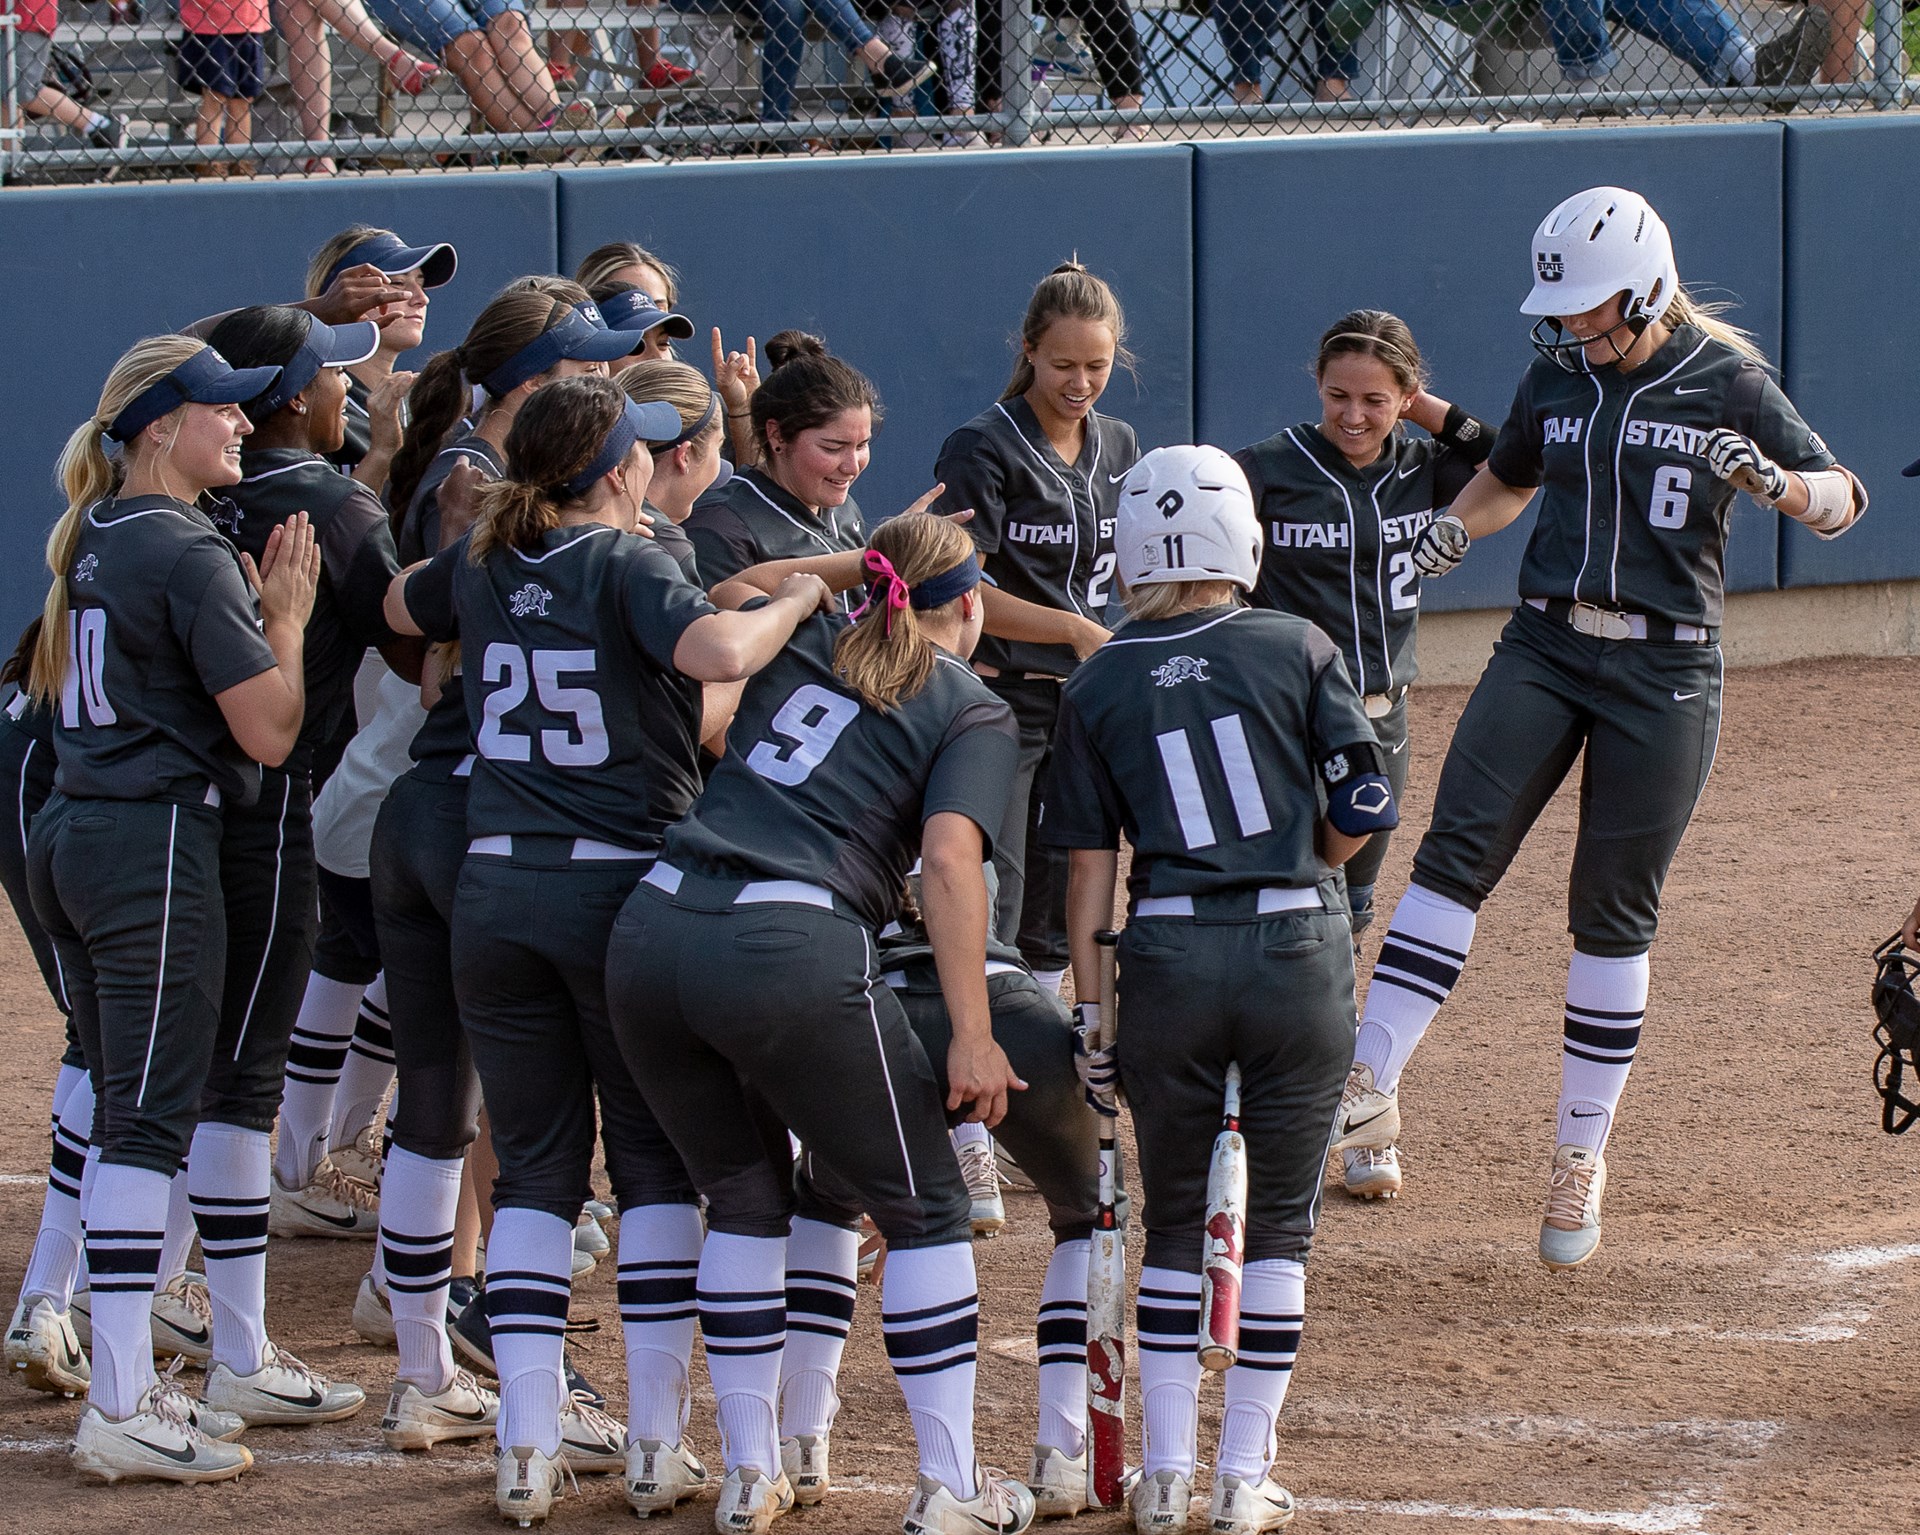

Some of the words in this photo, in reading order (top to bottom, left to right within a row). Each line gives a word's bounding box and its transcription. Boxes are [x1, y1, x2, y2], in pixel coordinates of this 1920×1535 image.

[1537, 261, 1564, 273] STATE
[1649, 465, 1692, 530] 6
[1008, 521, 1074, 545] UTAH
[1272, 521, 1349, 548] UTAH
[1162, 534, 1185, 569] 11
[1087, 552, 1117, 608] 2
[1389, 551, 1417, 611] 2
[61, 608, 117, 728] 10
[477, 642, 610, 766] 25
[746, 684, 860, 787] 9
[1156, 713, 1272, 850] 11
[508, 1489, 534, 1500] NIKE
[633, 1482, 658, 1493] NIKE
[797, 1476, 819, 1486] NIKE
[730, 1513, 754, 1525] NIKE
[1213, 1519, 1234, 1530] NIKE
